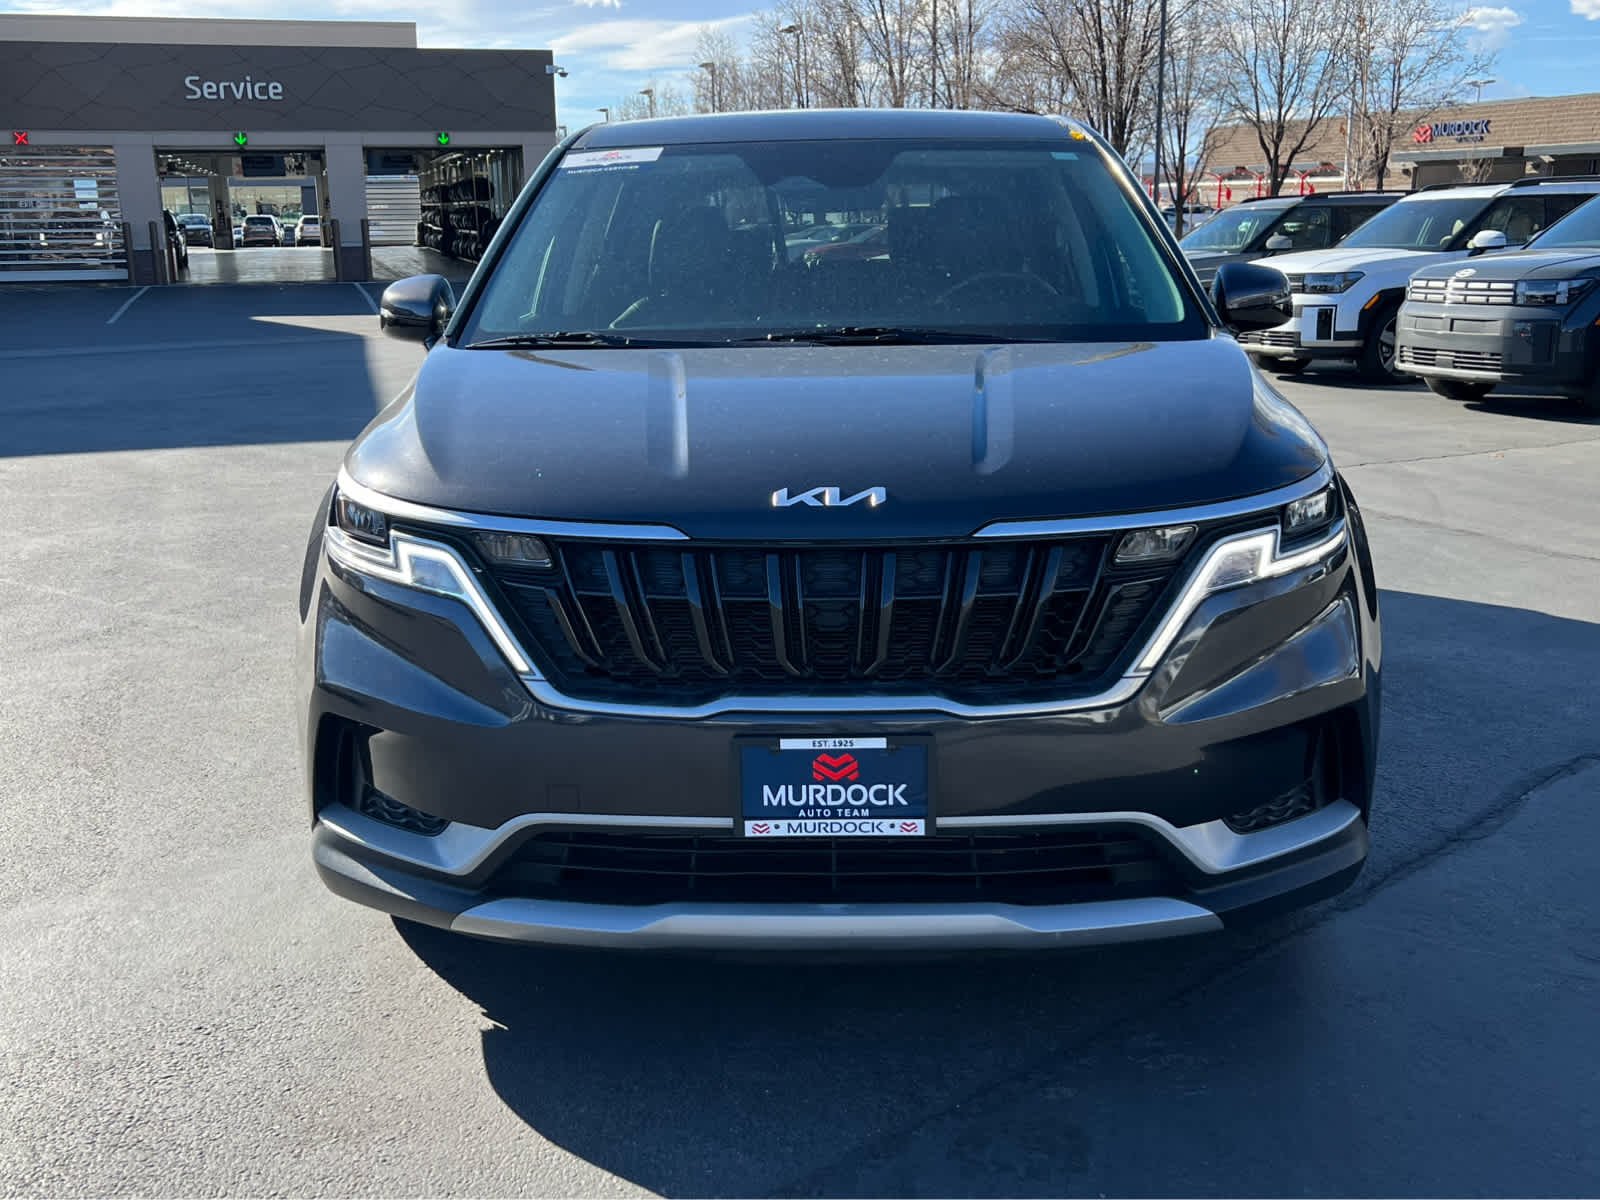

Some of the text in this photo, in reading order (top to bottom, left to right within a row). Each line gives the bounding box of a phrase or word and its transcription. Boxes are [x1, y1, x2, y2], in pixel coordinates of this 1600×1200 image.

[184, 76, 283, 100] Service
[1432, 120, 1491, 137] MURDOCK
[812, 740, 855, 748] EST. 1925
[762, 783, 909, 807] MURDOCK
[798, 808, 870, 817] AUTO TEAM
[786, 821, 884, 834] MURDOCK
